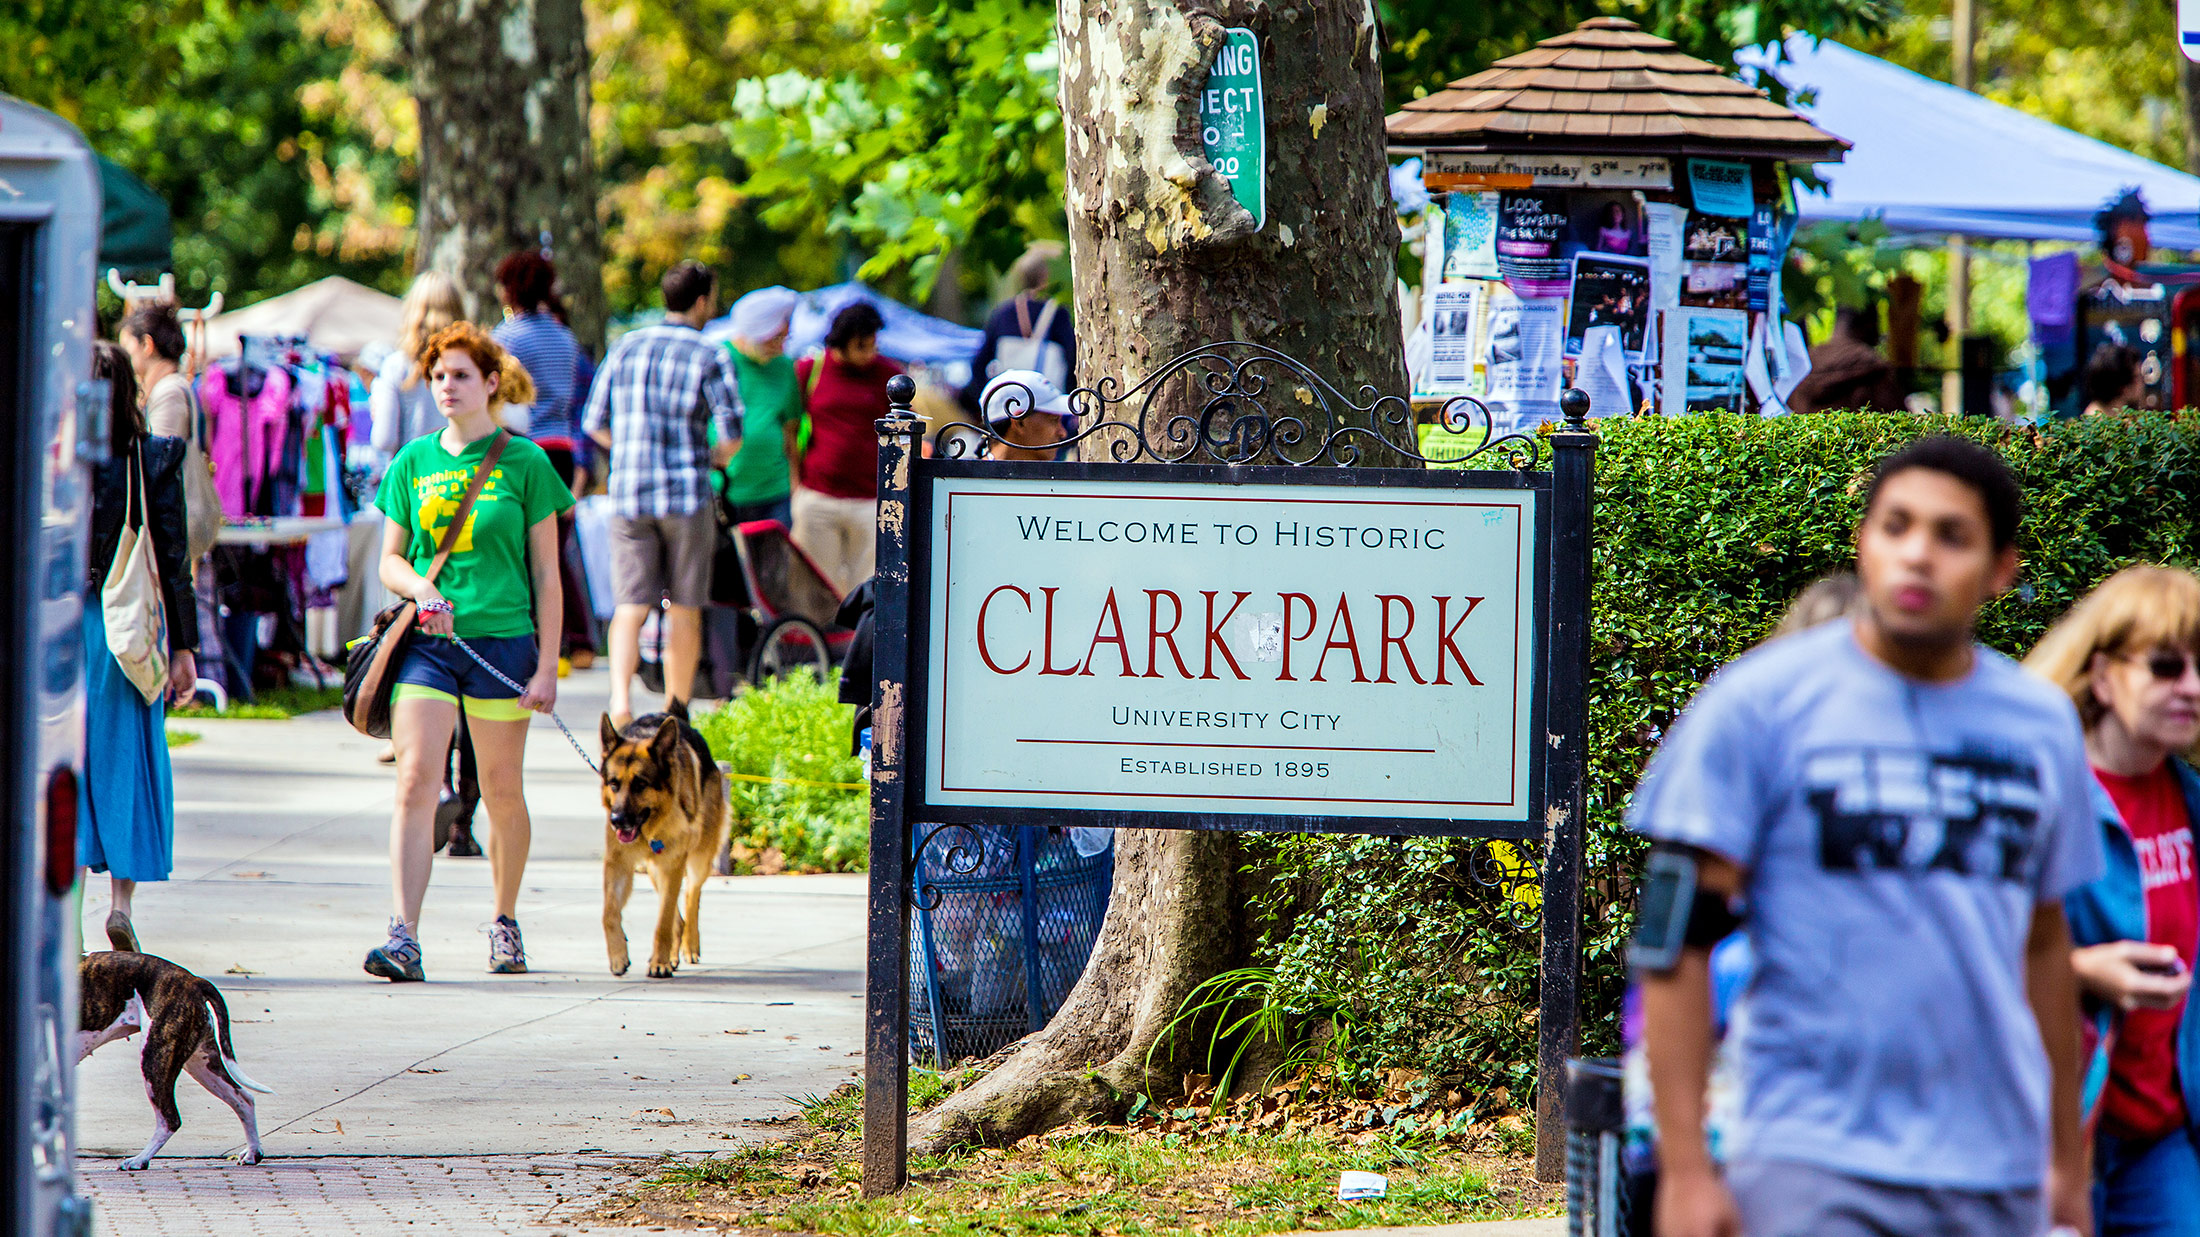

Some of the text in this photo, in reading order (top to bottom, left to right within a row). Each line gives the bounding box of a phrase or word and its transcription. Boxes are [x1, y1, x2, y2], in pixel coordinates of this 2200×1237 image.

[1210, 44, 1253, 76] ING
[1503, 162, 1581, 180] Thursday
[1504, 195, 1543, 215] LOOK
[1426, 447, 1471, 460] UHUR
[413, 468, 468, 490] Nothing
[1016, 515, 1446, 550] WELCOME TO HISTORIC
[976, 584, 1486, 686] CLARK PARK
[1112, 706, 1341, 731] UNIVERSITY CITY
[1120, 757, 1331, 778] ESTABLISHED 1895
